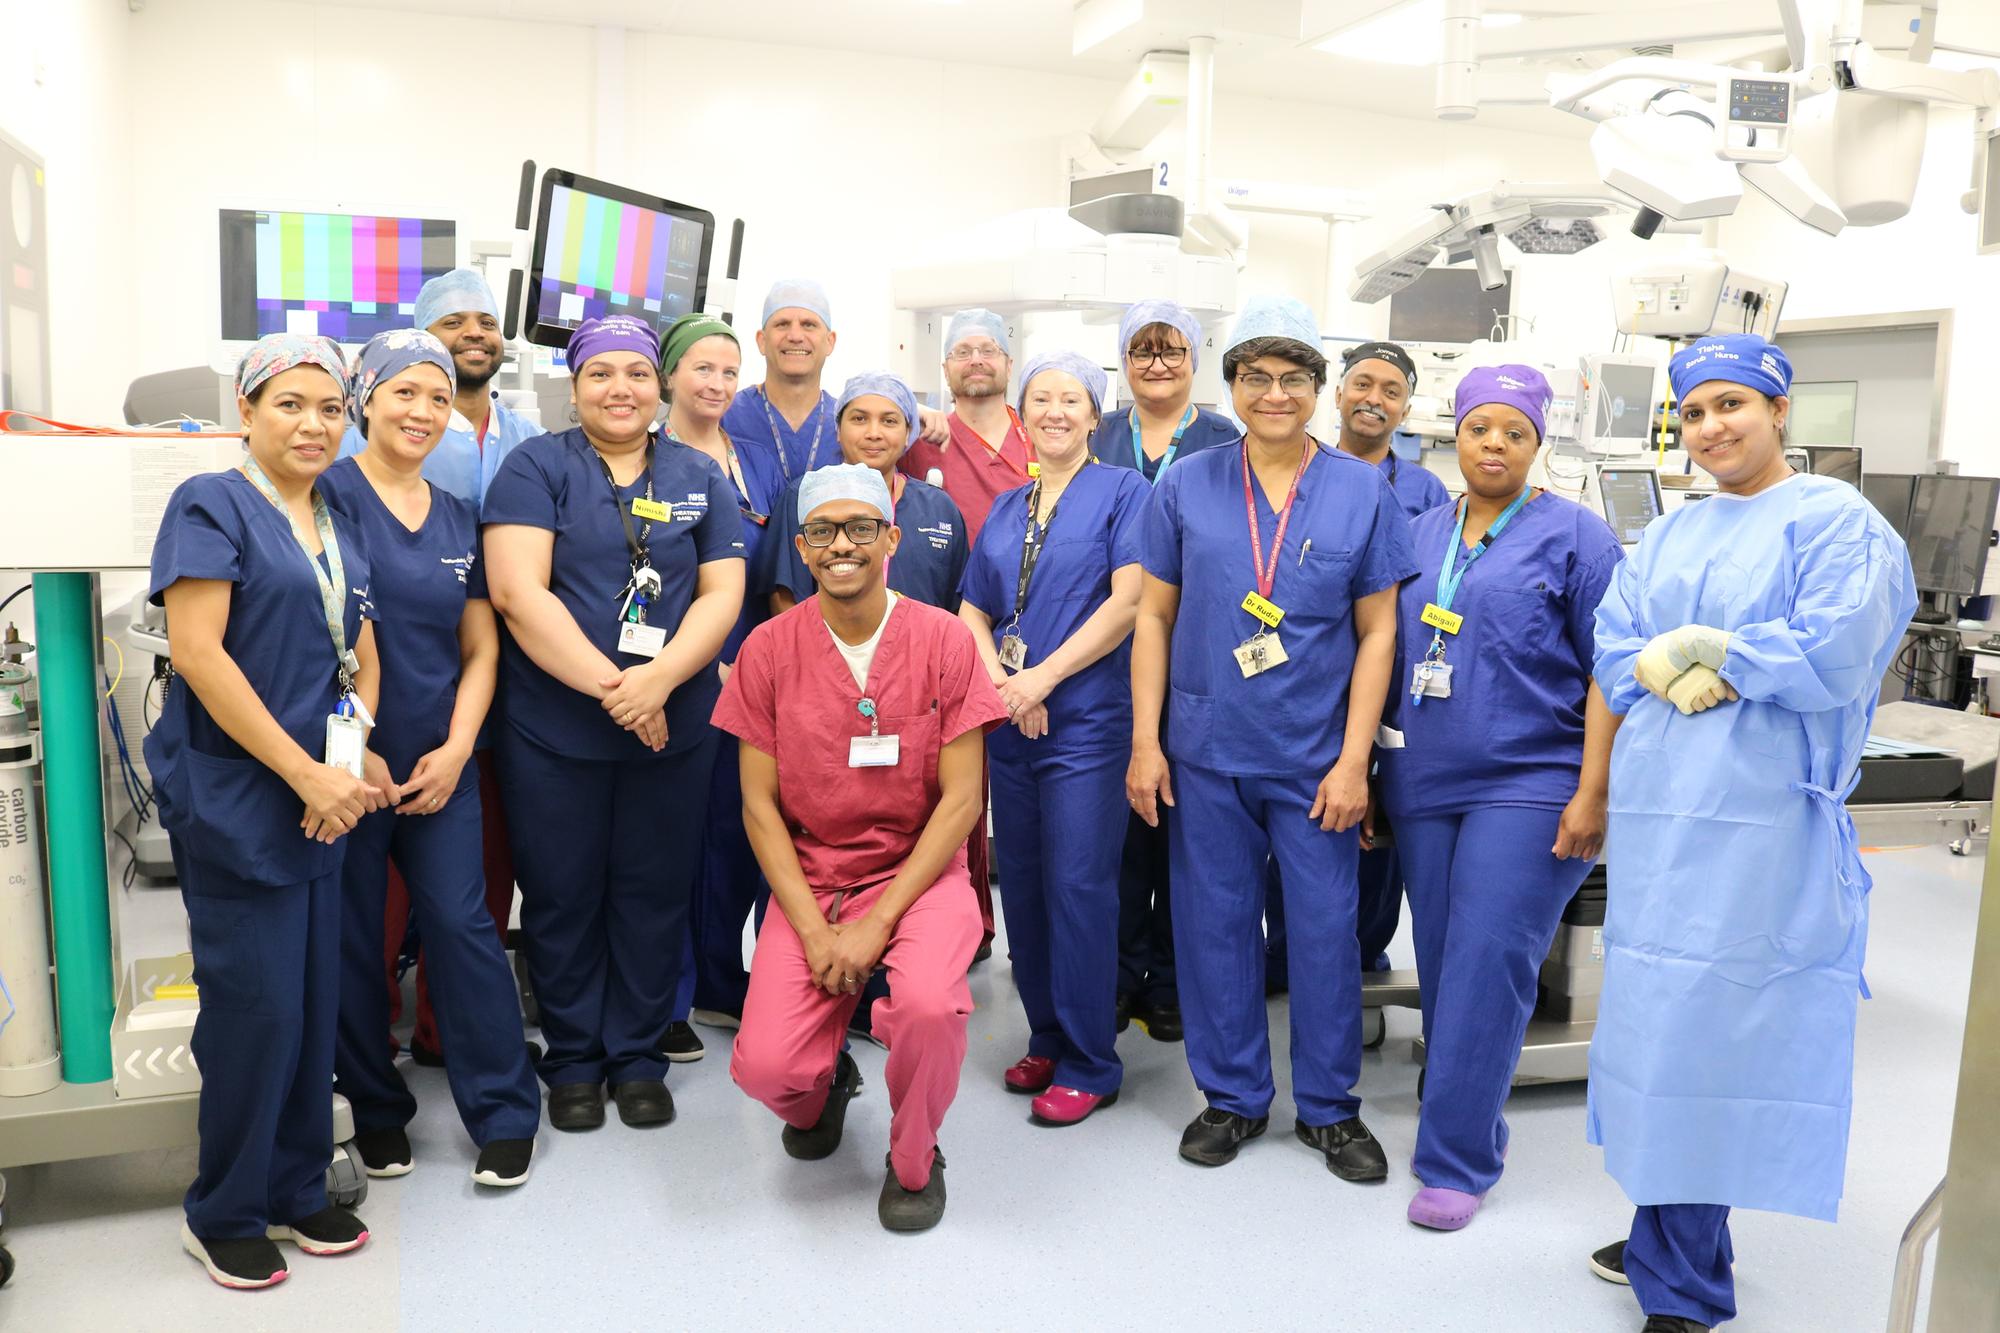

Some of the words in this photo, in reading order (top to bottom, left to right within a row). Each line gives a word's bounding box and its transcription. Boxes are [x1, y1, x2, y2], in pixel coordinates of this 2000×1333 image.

[1159, 162, 1169, 186] 2
[928, 323, 931, 334] 1
[1008, 326, 1014, 338] 2
[1206, 337, 1213, 348] 4
[1697, 344, 1725, 354] Tisha
[1714, 352, 1739, 360] Nurse
[688, 493, 706, 501] NHS
[1246, 598, 1255, 607] Dr
[1256, 604, 1279, 622] Rudra
[1427, 612, 1456, 627] Abigail
[0, 790, 12, 848] dioxide
[12, 788, 28, 844] carbon
